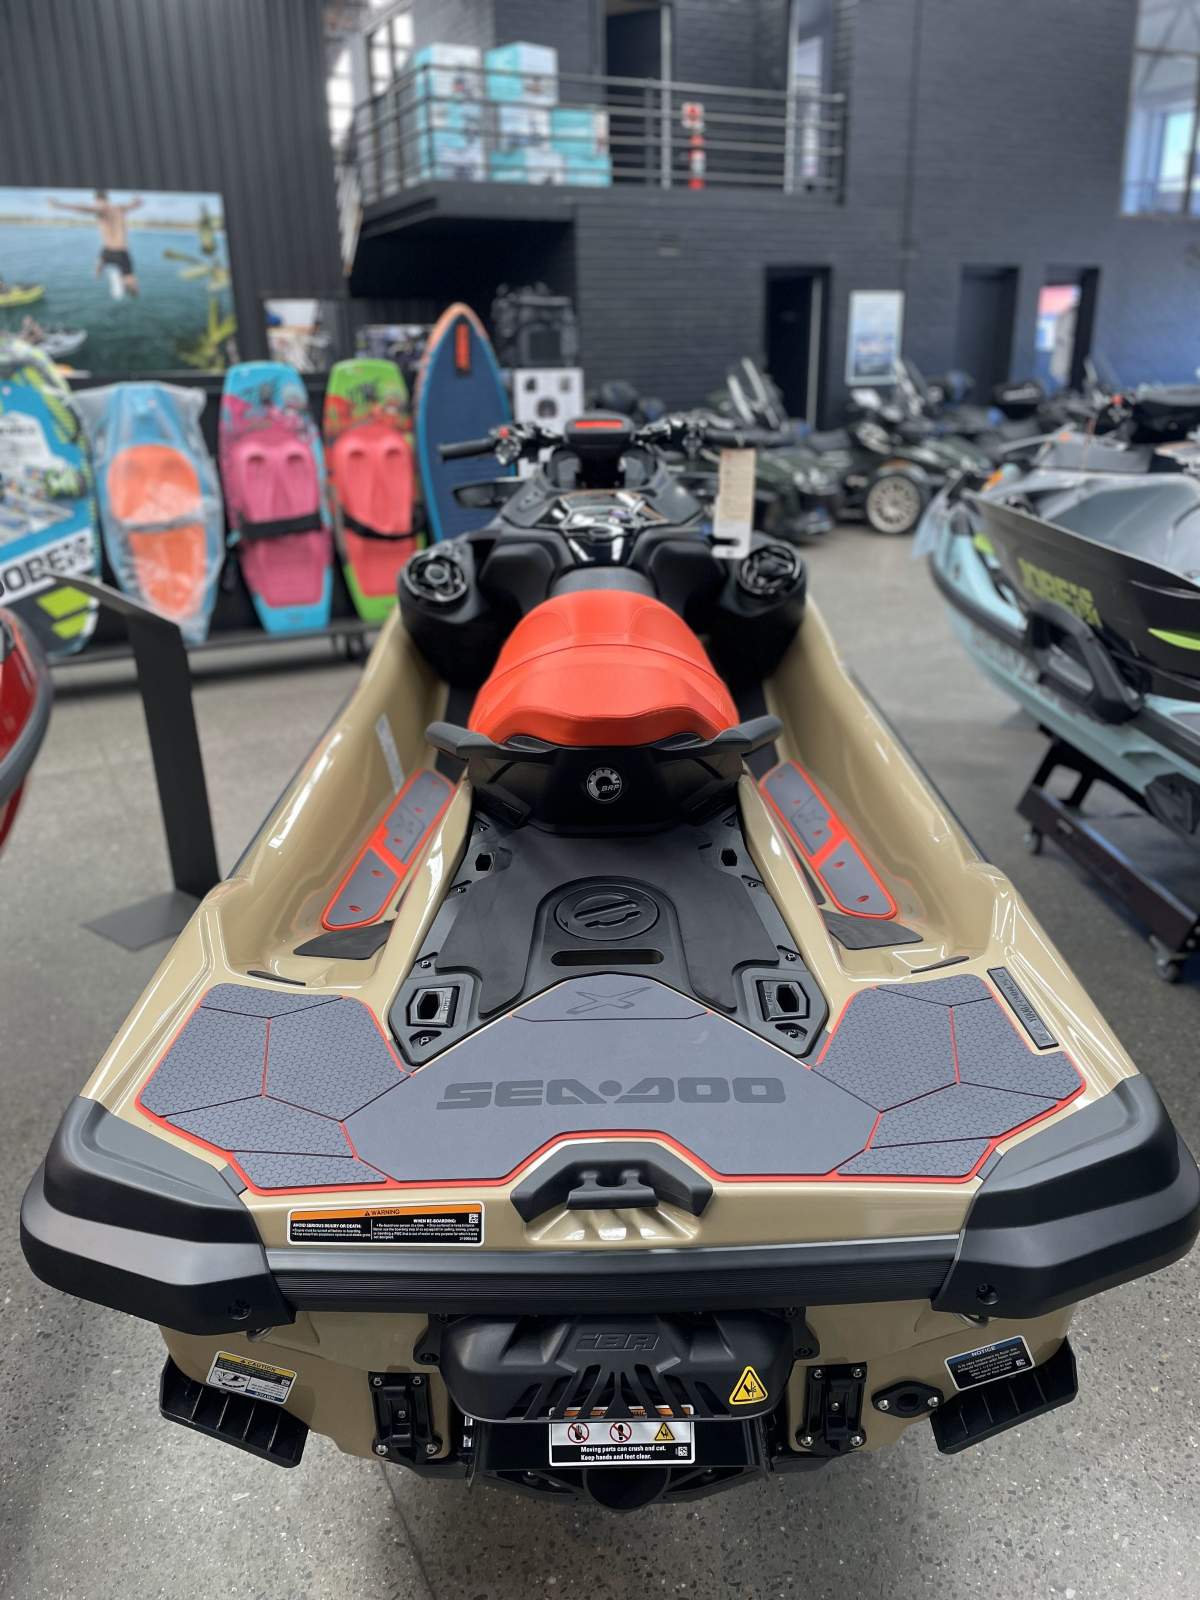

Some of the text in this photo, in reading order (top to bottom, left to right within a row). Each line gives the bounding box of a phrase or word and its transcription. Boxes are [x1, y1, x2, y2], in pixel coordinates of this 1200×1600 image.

[601, 784, 620, 792] BRP
[971, 1346, 997, 1357] NOTICE
[247, 1360, 276, 1372] CAUTION
